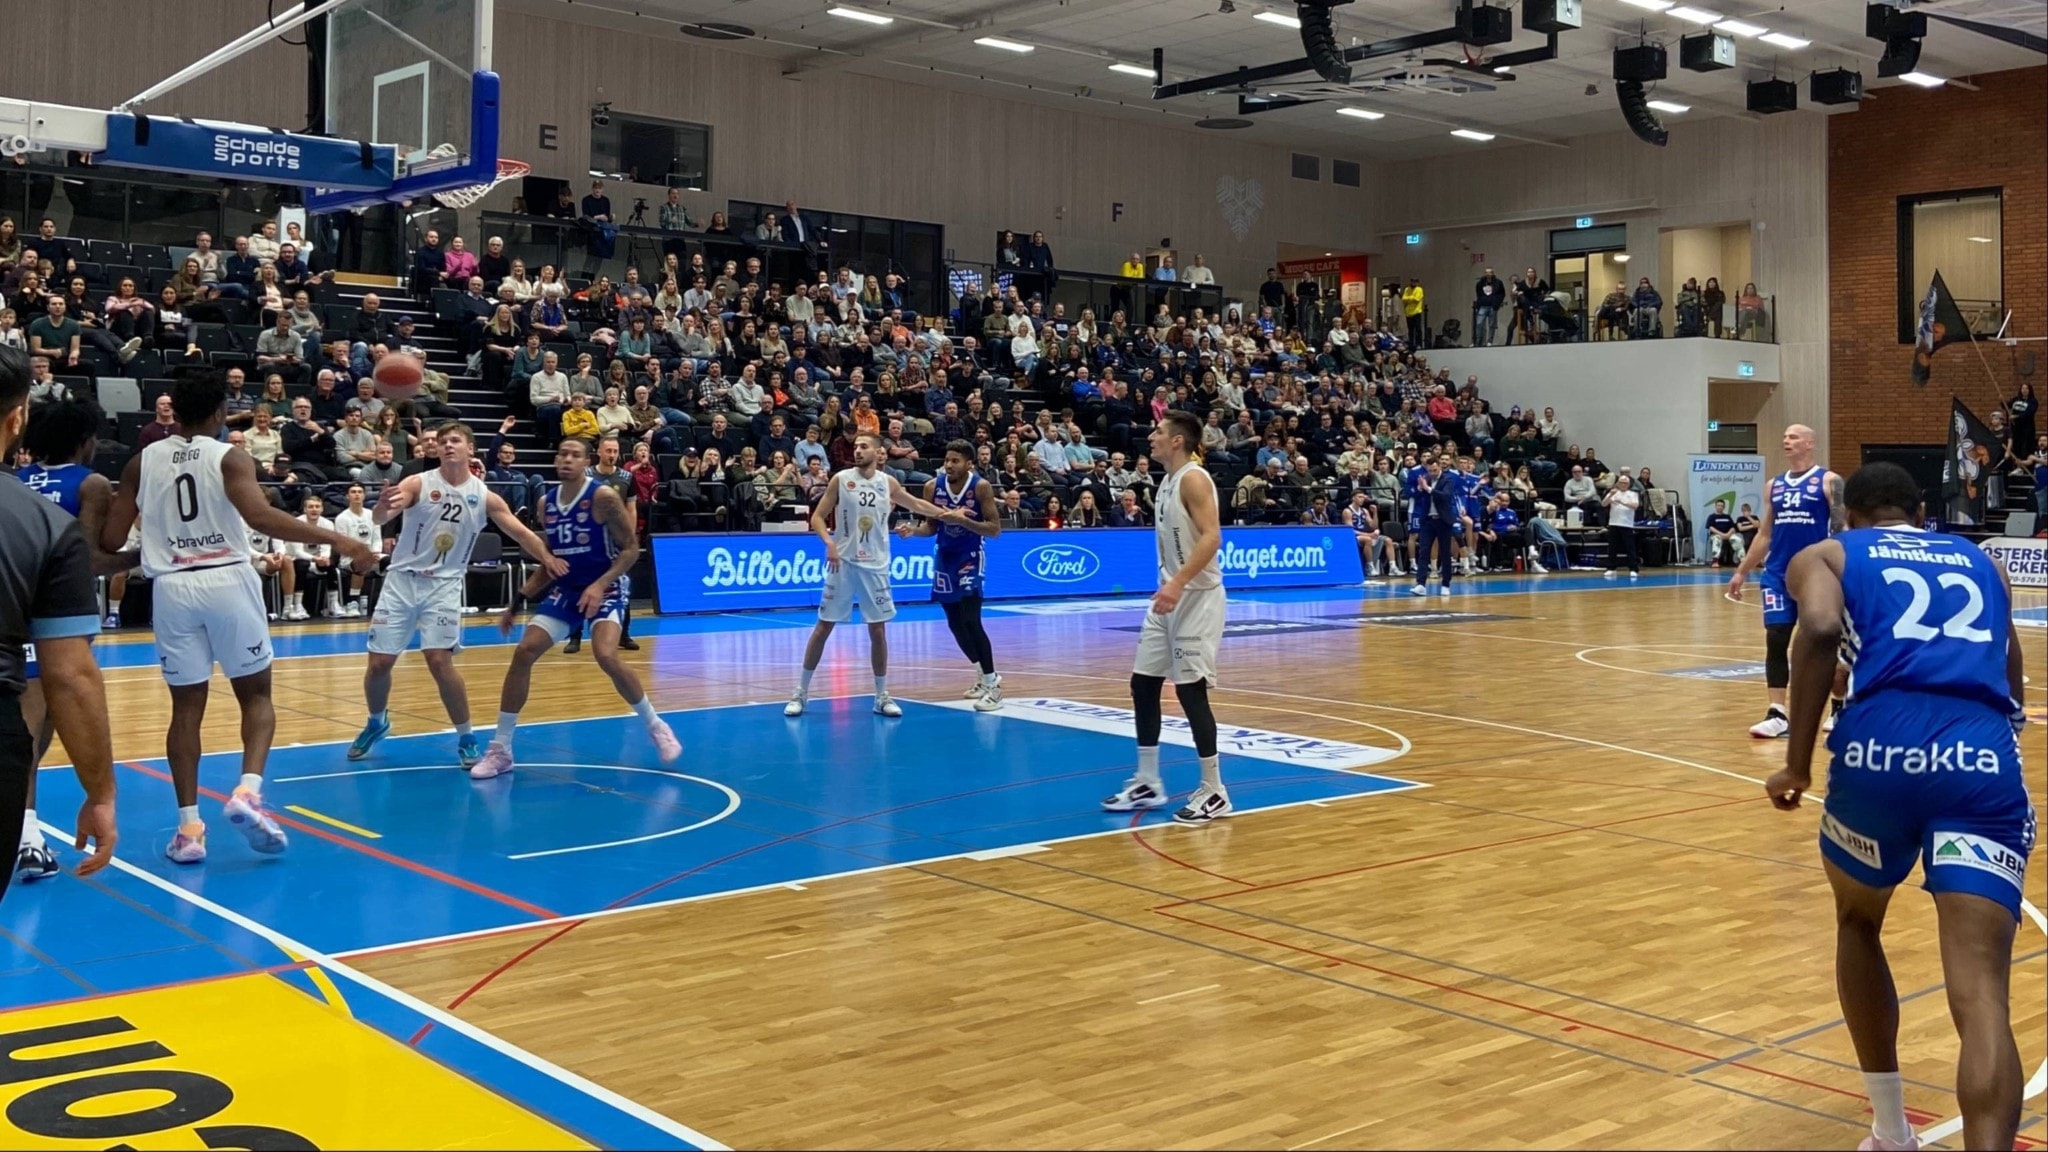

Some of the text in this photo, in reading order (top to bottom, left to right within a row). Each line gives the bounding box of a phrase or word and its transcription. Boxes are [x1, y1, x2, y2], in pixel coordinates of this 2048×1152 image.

[214, 134, 301, 157] Schelde
[540, 124, 558, 151] E
[214, 148, 300, 170] Sports
[1112, 202, 1123, 222] F
[1694, 461, 1760, 471] LUNDSTAMS
[175, 473, 199, 522] 0
[859, 491, 876, 507] 32
[1782, 491, 1801, 508] 34
[440, 502, 462, 523] 22
[176, 532, 225, 549] bravida
[556, 523, 573, 544] 15
[1037, 549, 1086, 575] Ford
[1868, 546, 1973, 568] Jämtkraft
[1881, 567, 1993, 643] 22
[1844, 738, 2000, 774] atrakta
[1846, 832, 1876, 857] JBH
